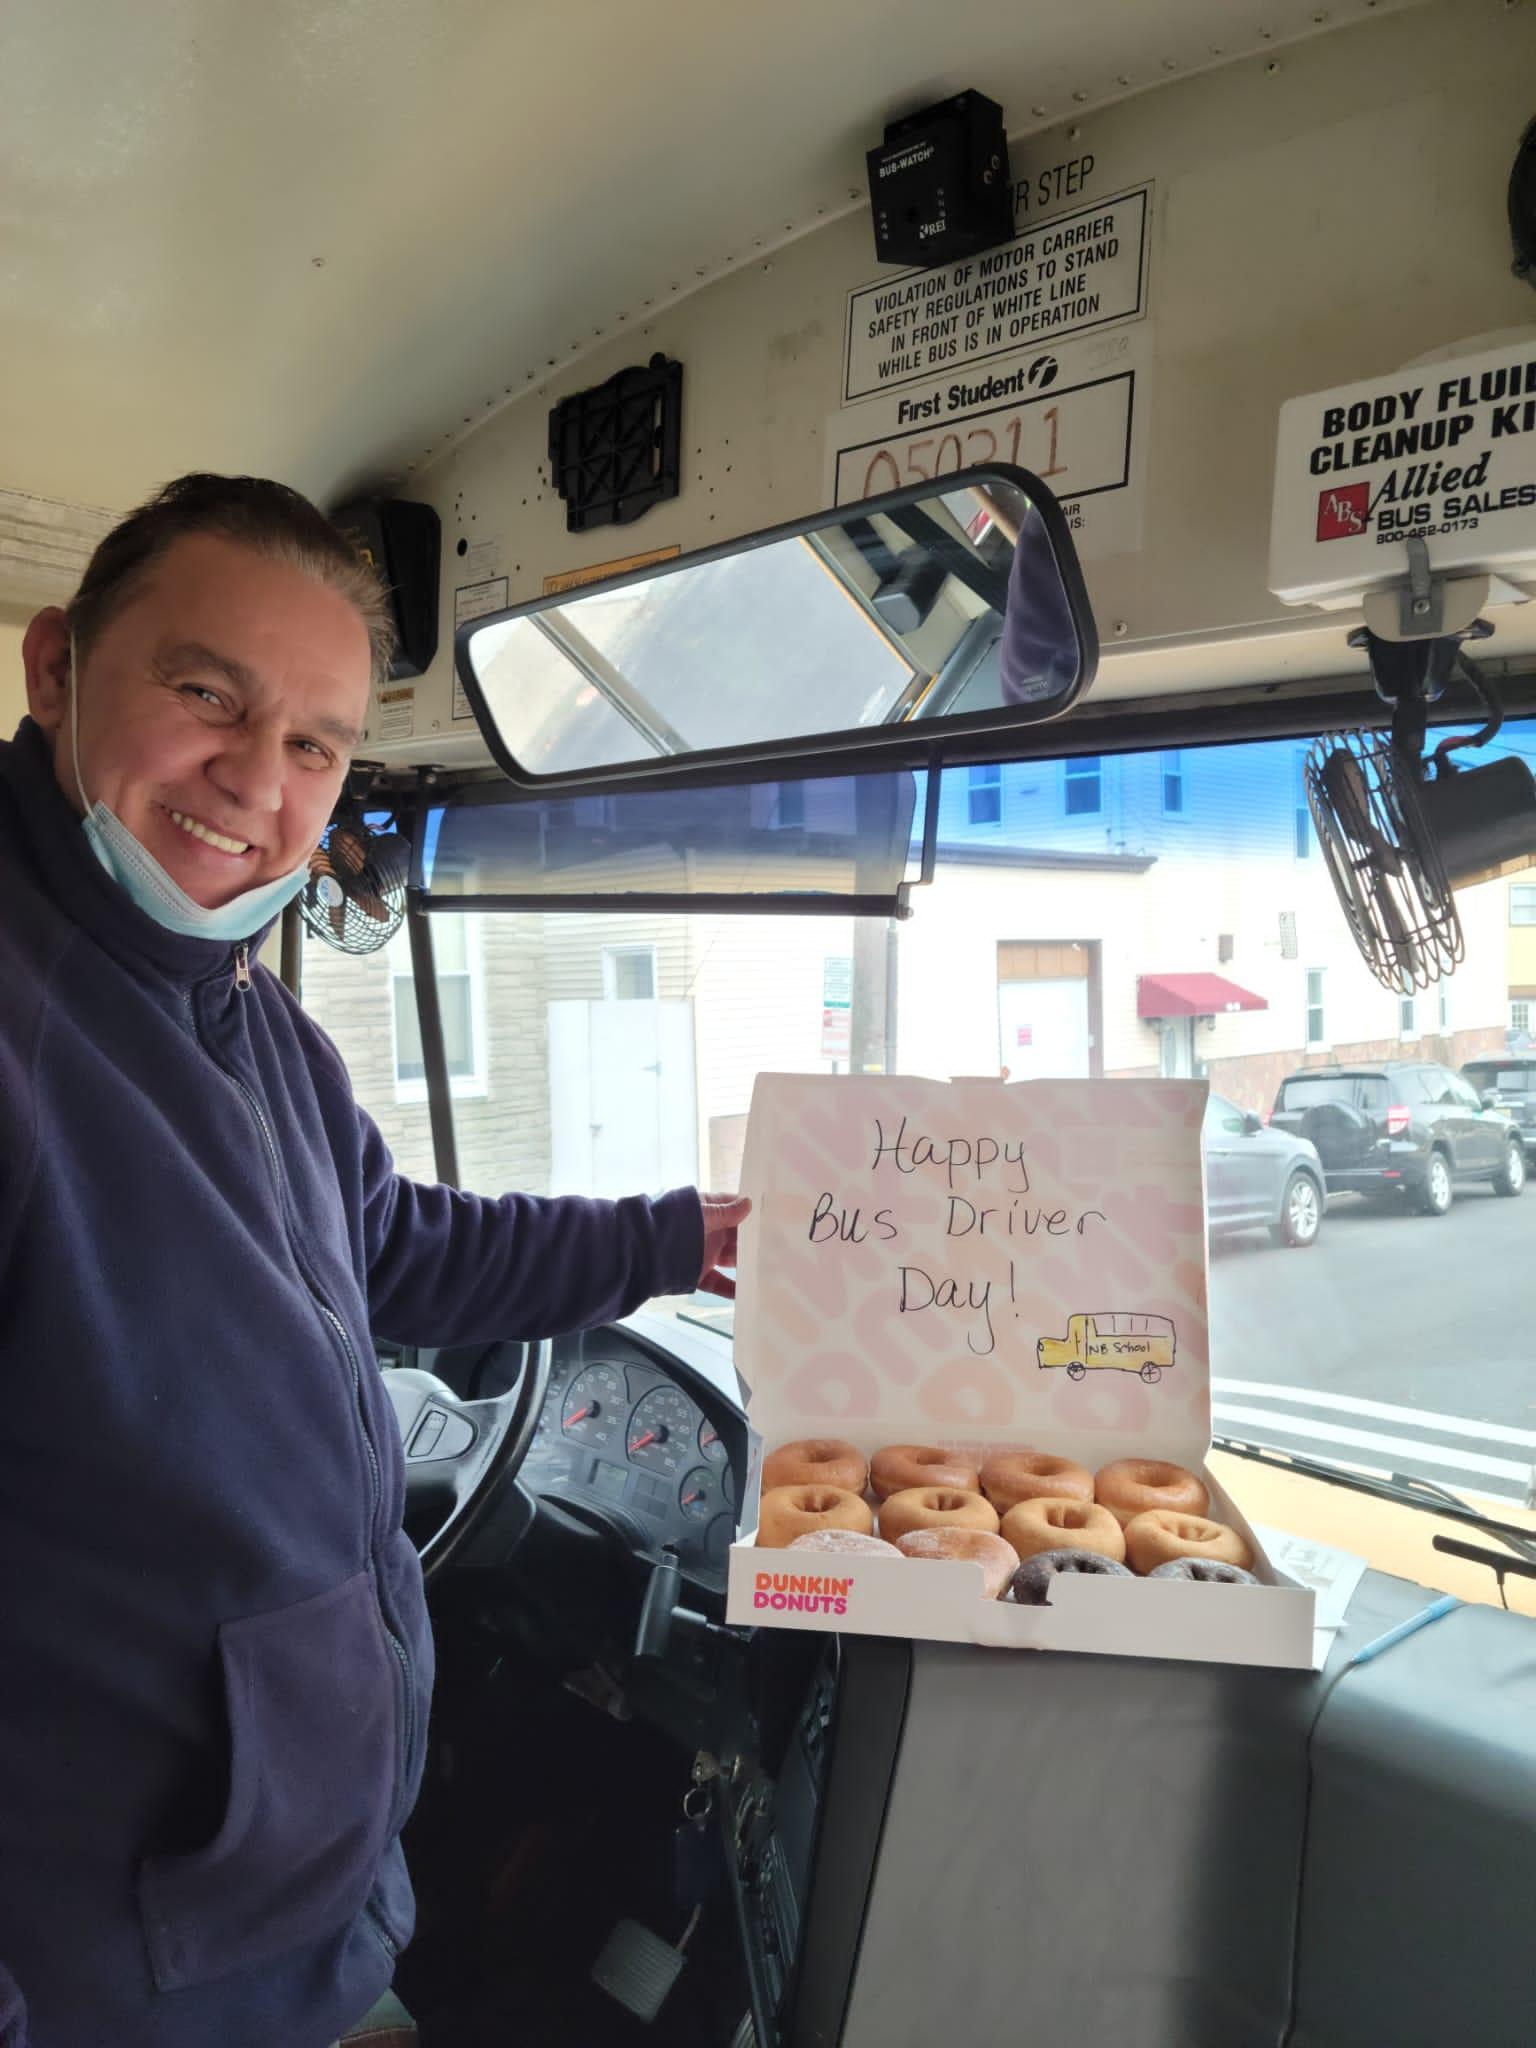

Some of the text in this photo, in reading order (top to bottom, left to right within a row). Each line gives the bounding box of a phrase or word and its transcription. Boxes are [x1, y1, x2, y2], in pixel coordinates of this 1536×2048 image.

[1038, 154, 1095, 206] STEP
[868, 238, 1119, 339] SAFETY REGULATIONS TO STAND
[875, 215, 1114, 315] VIOLATION OF MOTOR CARRIER
[878, 293, 1100, 379] WHILE BUS IS IN OPERATION
[891, 273, 1087, 353] IN FRONT OF WHITE LINE
[898, 367, 1025, 425] First Student
[1322, 387, 1424, 439] BODY
[1309, 400, 1536, 476] CLEANUP KI
[1323, 493, 1363, 533] ABS
[1366, 450, 1492, 523] Allied
[1377, 484, 1536, 531] BUS SALES
[872, 1115, 1029, 1194] Happy
[808, 1192, 1106, 1244] Bus Driver
[898, 1260, 1020, 1356] Day!
[1089, 1341, 1151, 1355] NB School
[753, 1591, 848, 1615] DONUTS
[755, 1572, 855, 1597] DUNKIN'
